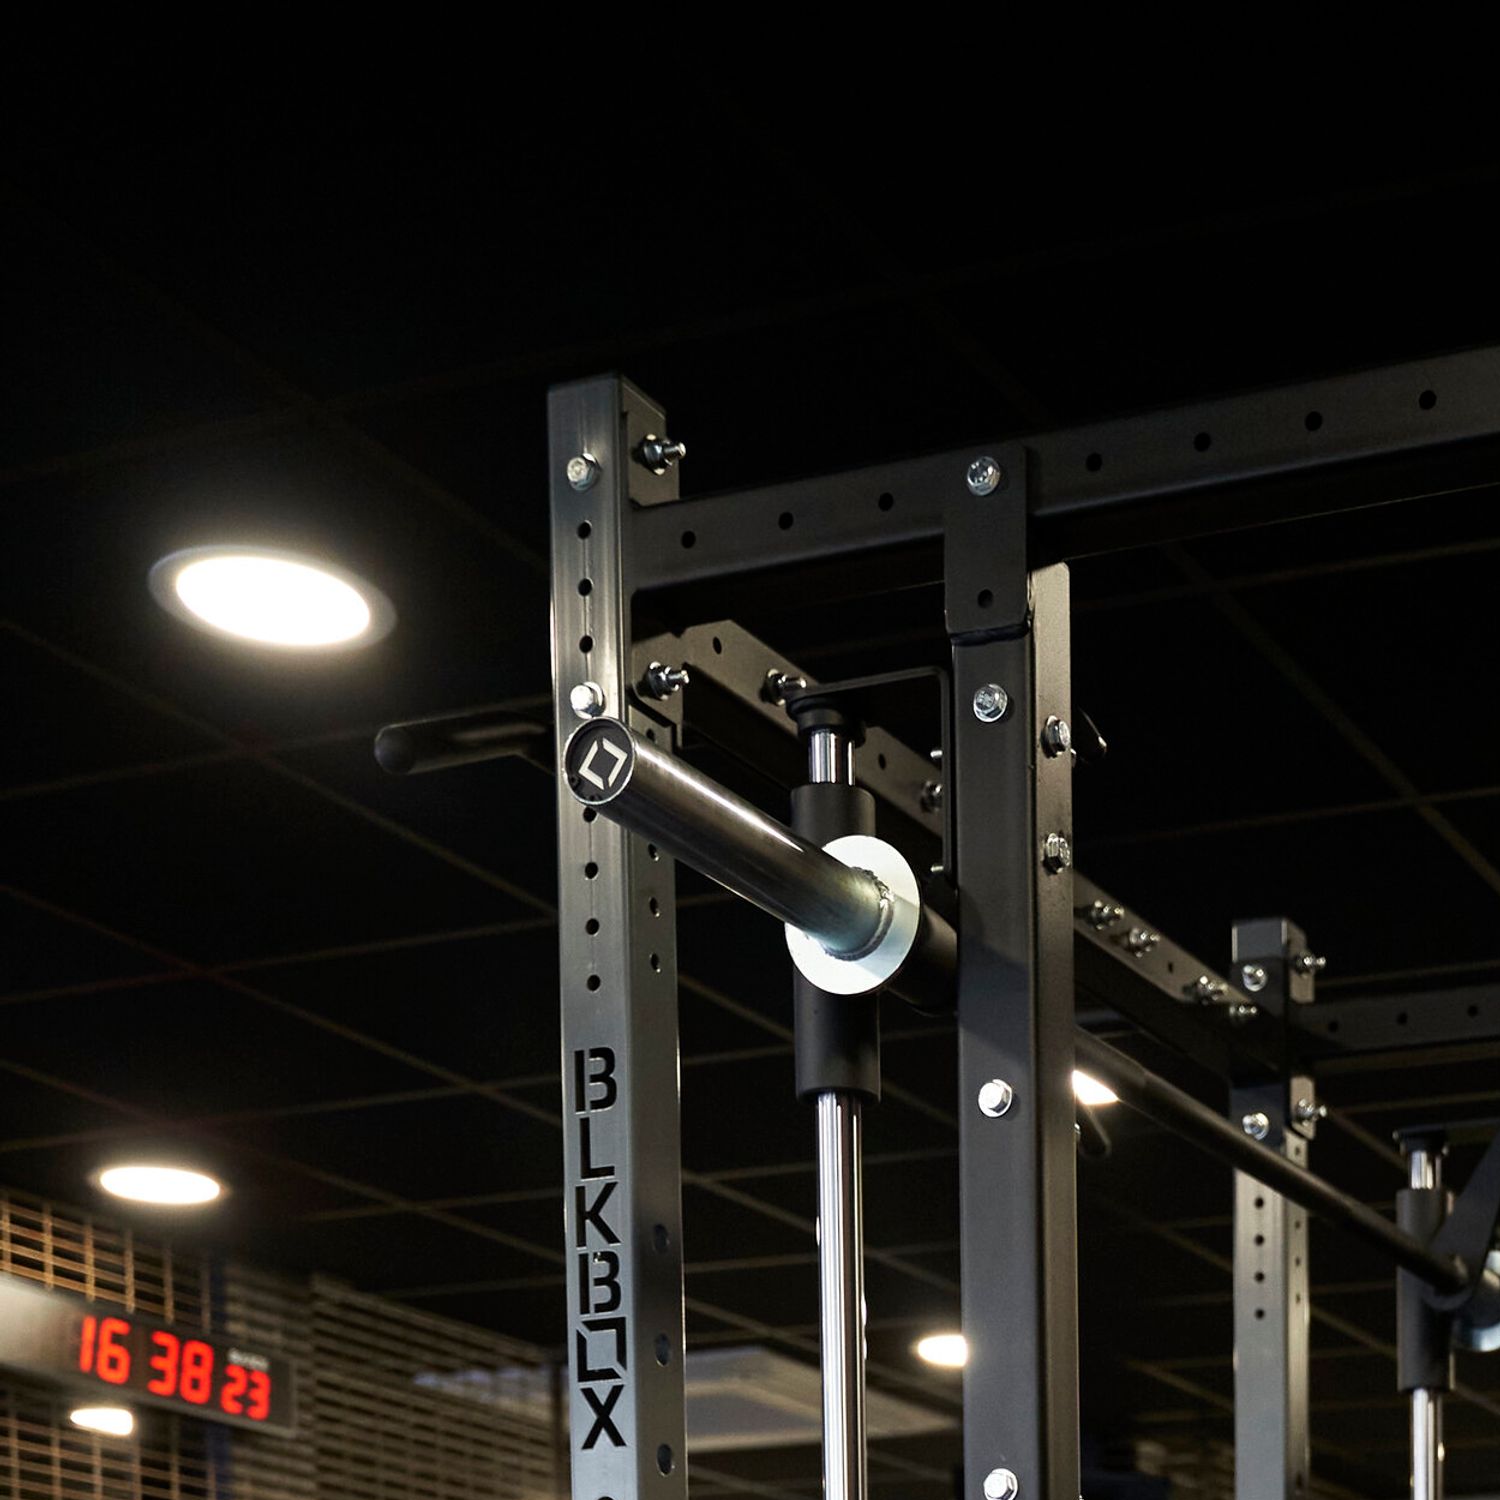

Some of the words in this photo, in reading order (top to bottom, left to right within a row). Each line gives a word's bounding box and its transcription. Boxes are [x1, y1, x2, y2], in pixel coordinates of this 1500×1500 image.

[79, 1315, 131, 1385] 16
[147, 1330, 215, 1405] 38
[220, 1364, 271, 1421] 23
[574, 1045, 627, 1451] BLKBOX
